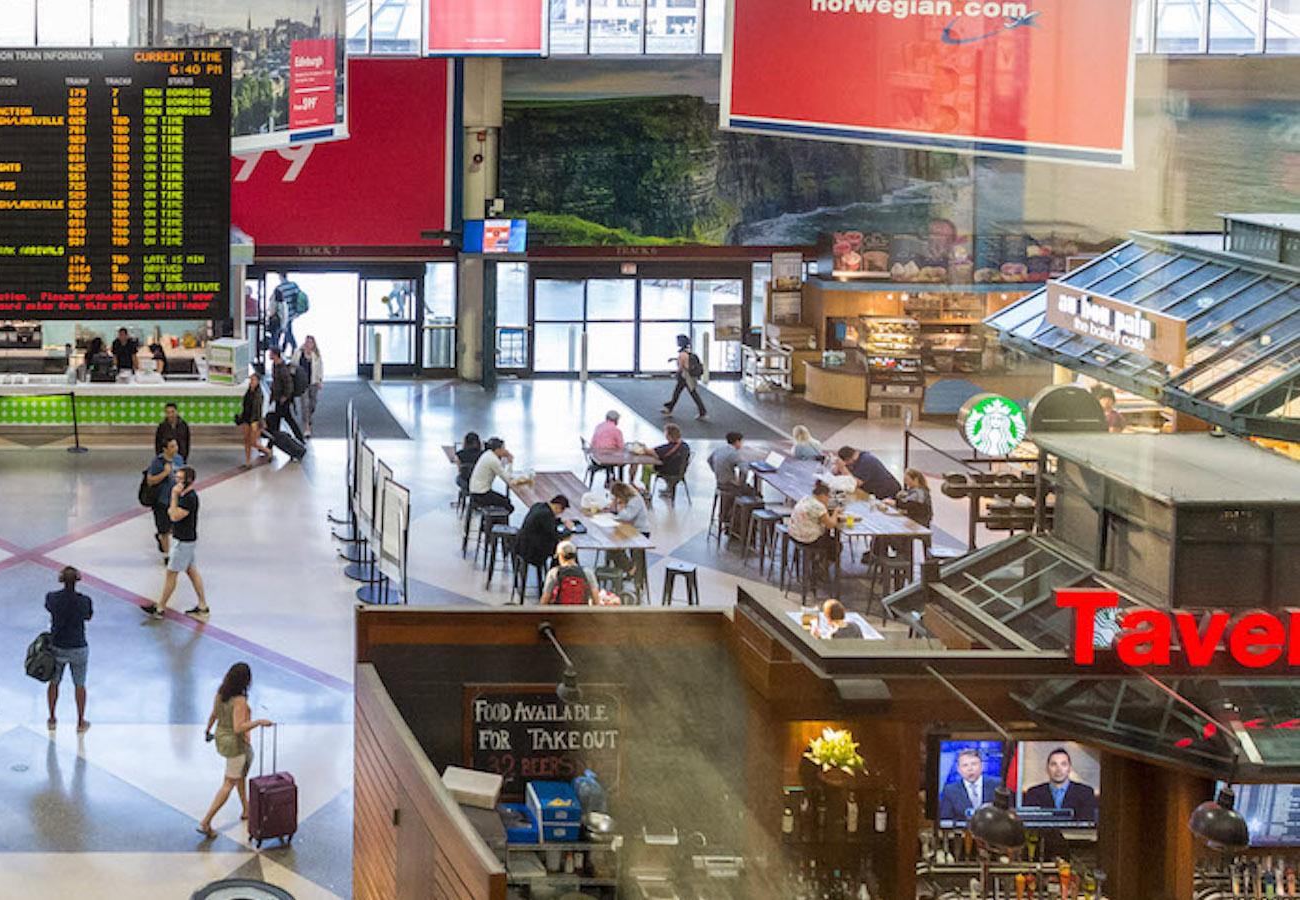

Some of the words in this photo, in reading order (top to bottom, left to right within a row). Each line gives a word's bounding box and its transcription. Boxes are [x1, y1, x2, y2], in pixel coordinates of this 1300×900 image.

[812, 0, 1028, 18] norwegian.com
[15, 51, 42, 61] TRAIN
[43, 51, 104, 61] INFORMATION
[134, 51, 185, 62] CURRENT
[193, 51, 221, 62] TIME
[170, 64, 201, 75] 6:40
[206, 64, 222, 75] PM
[167, 77, 194, 86] STATUS
[1081, 294, 1111, 327] bon
[1114, 310, 1152, 341] pain
[1073, 316, 1089, 333] the
[1090, 321, 1121, 345] bakery
[475, 699, 511, 722] FOOD
[514, 701, 608, 722] AVAILABLE
[479, 729, 512, 750] FOR
